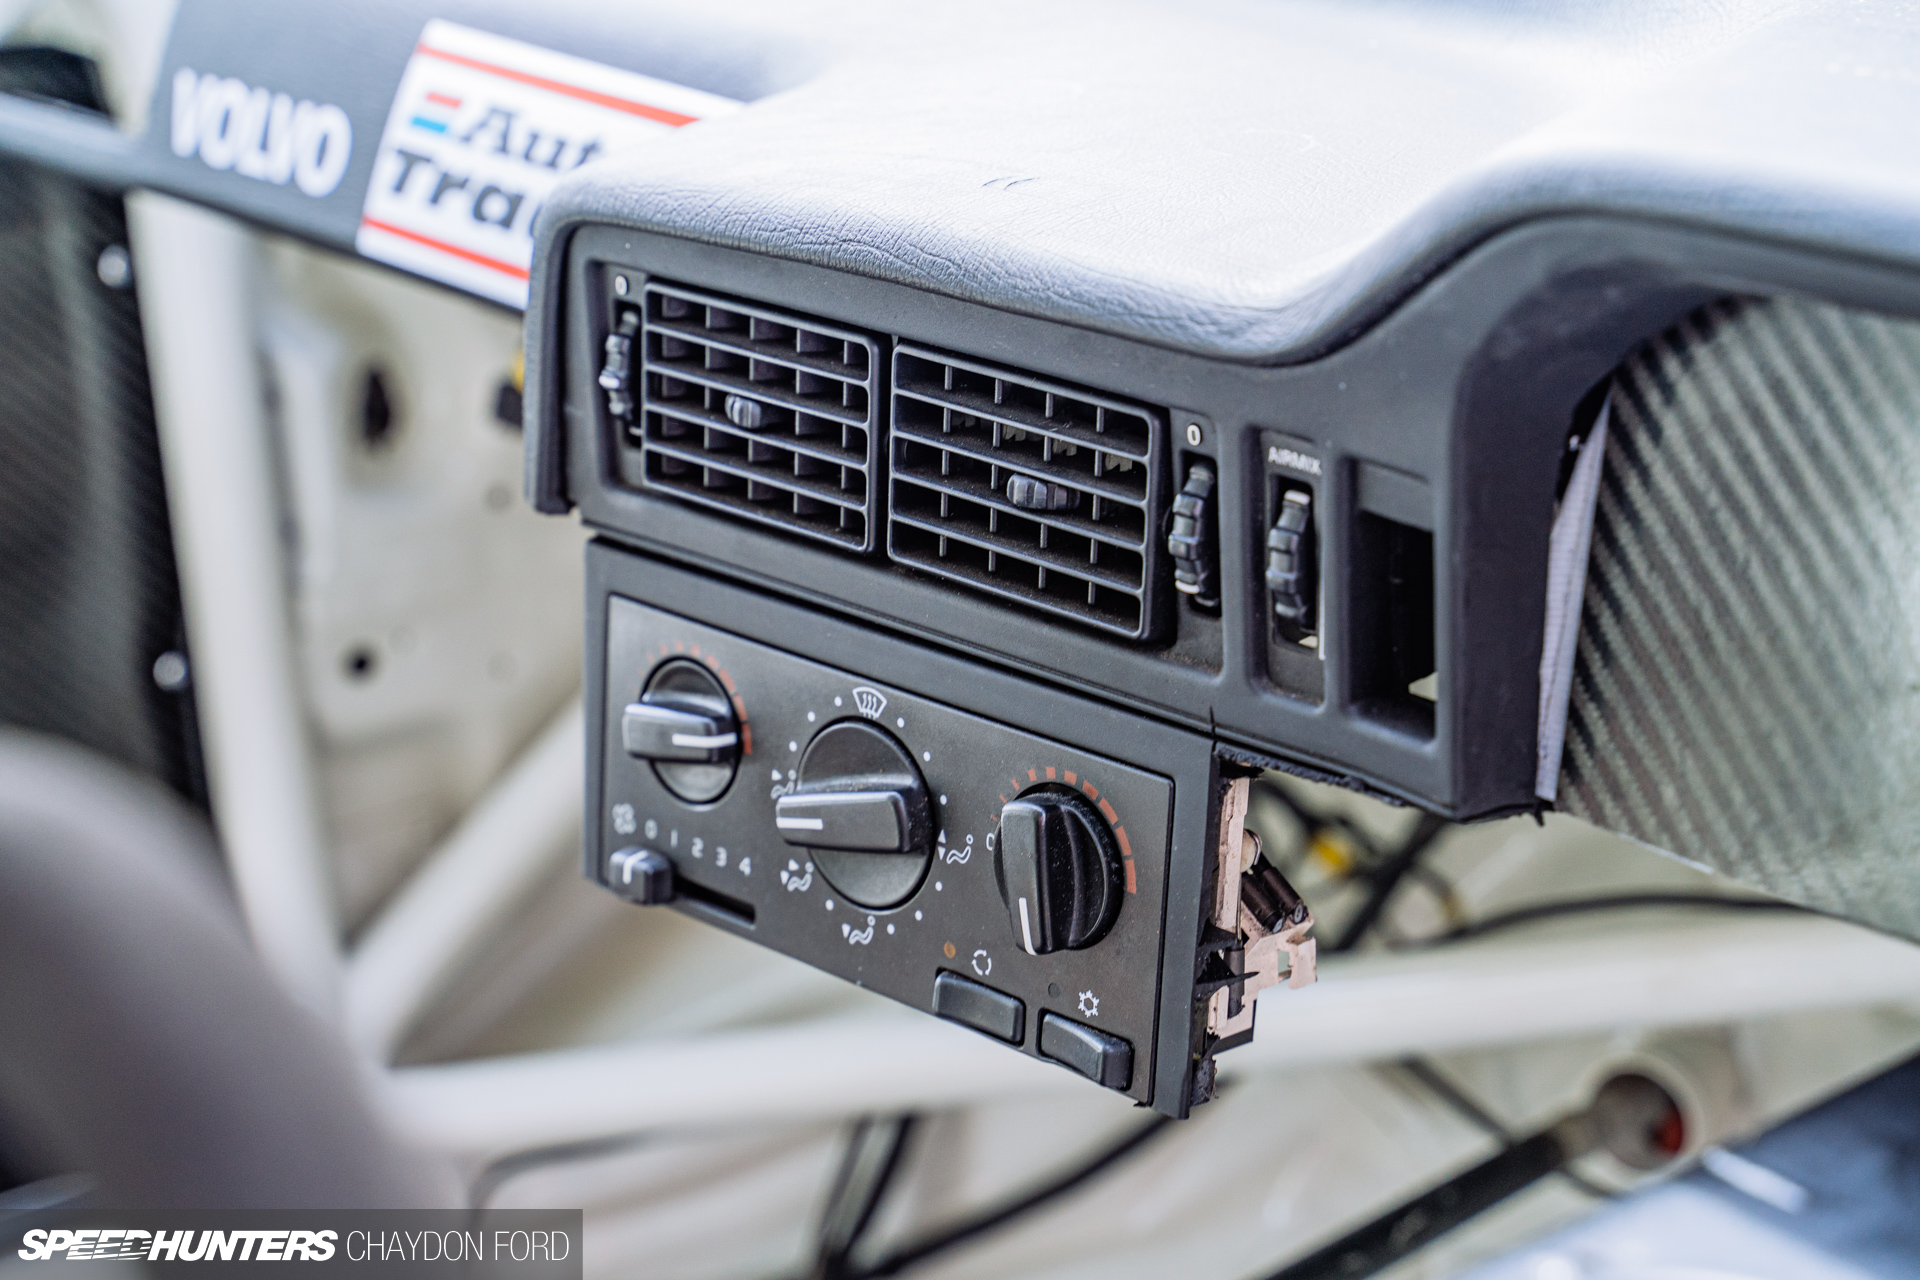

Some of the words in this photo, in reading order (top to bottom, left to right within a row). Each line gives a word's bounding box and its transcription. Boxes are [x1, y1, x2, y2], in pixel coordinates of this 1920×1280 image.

[171, 67, 352, 198] VOLVO
[1187, 424, 1201, 446] 0
[1268, 446, 1323, 476] AIRMIX
[691, 837, 704, 859] 2
[715, 846, 728, 868] 3
[738, 856, 752, 877] 4
